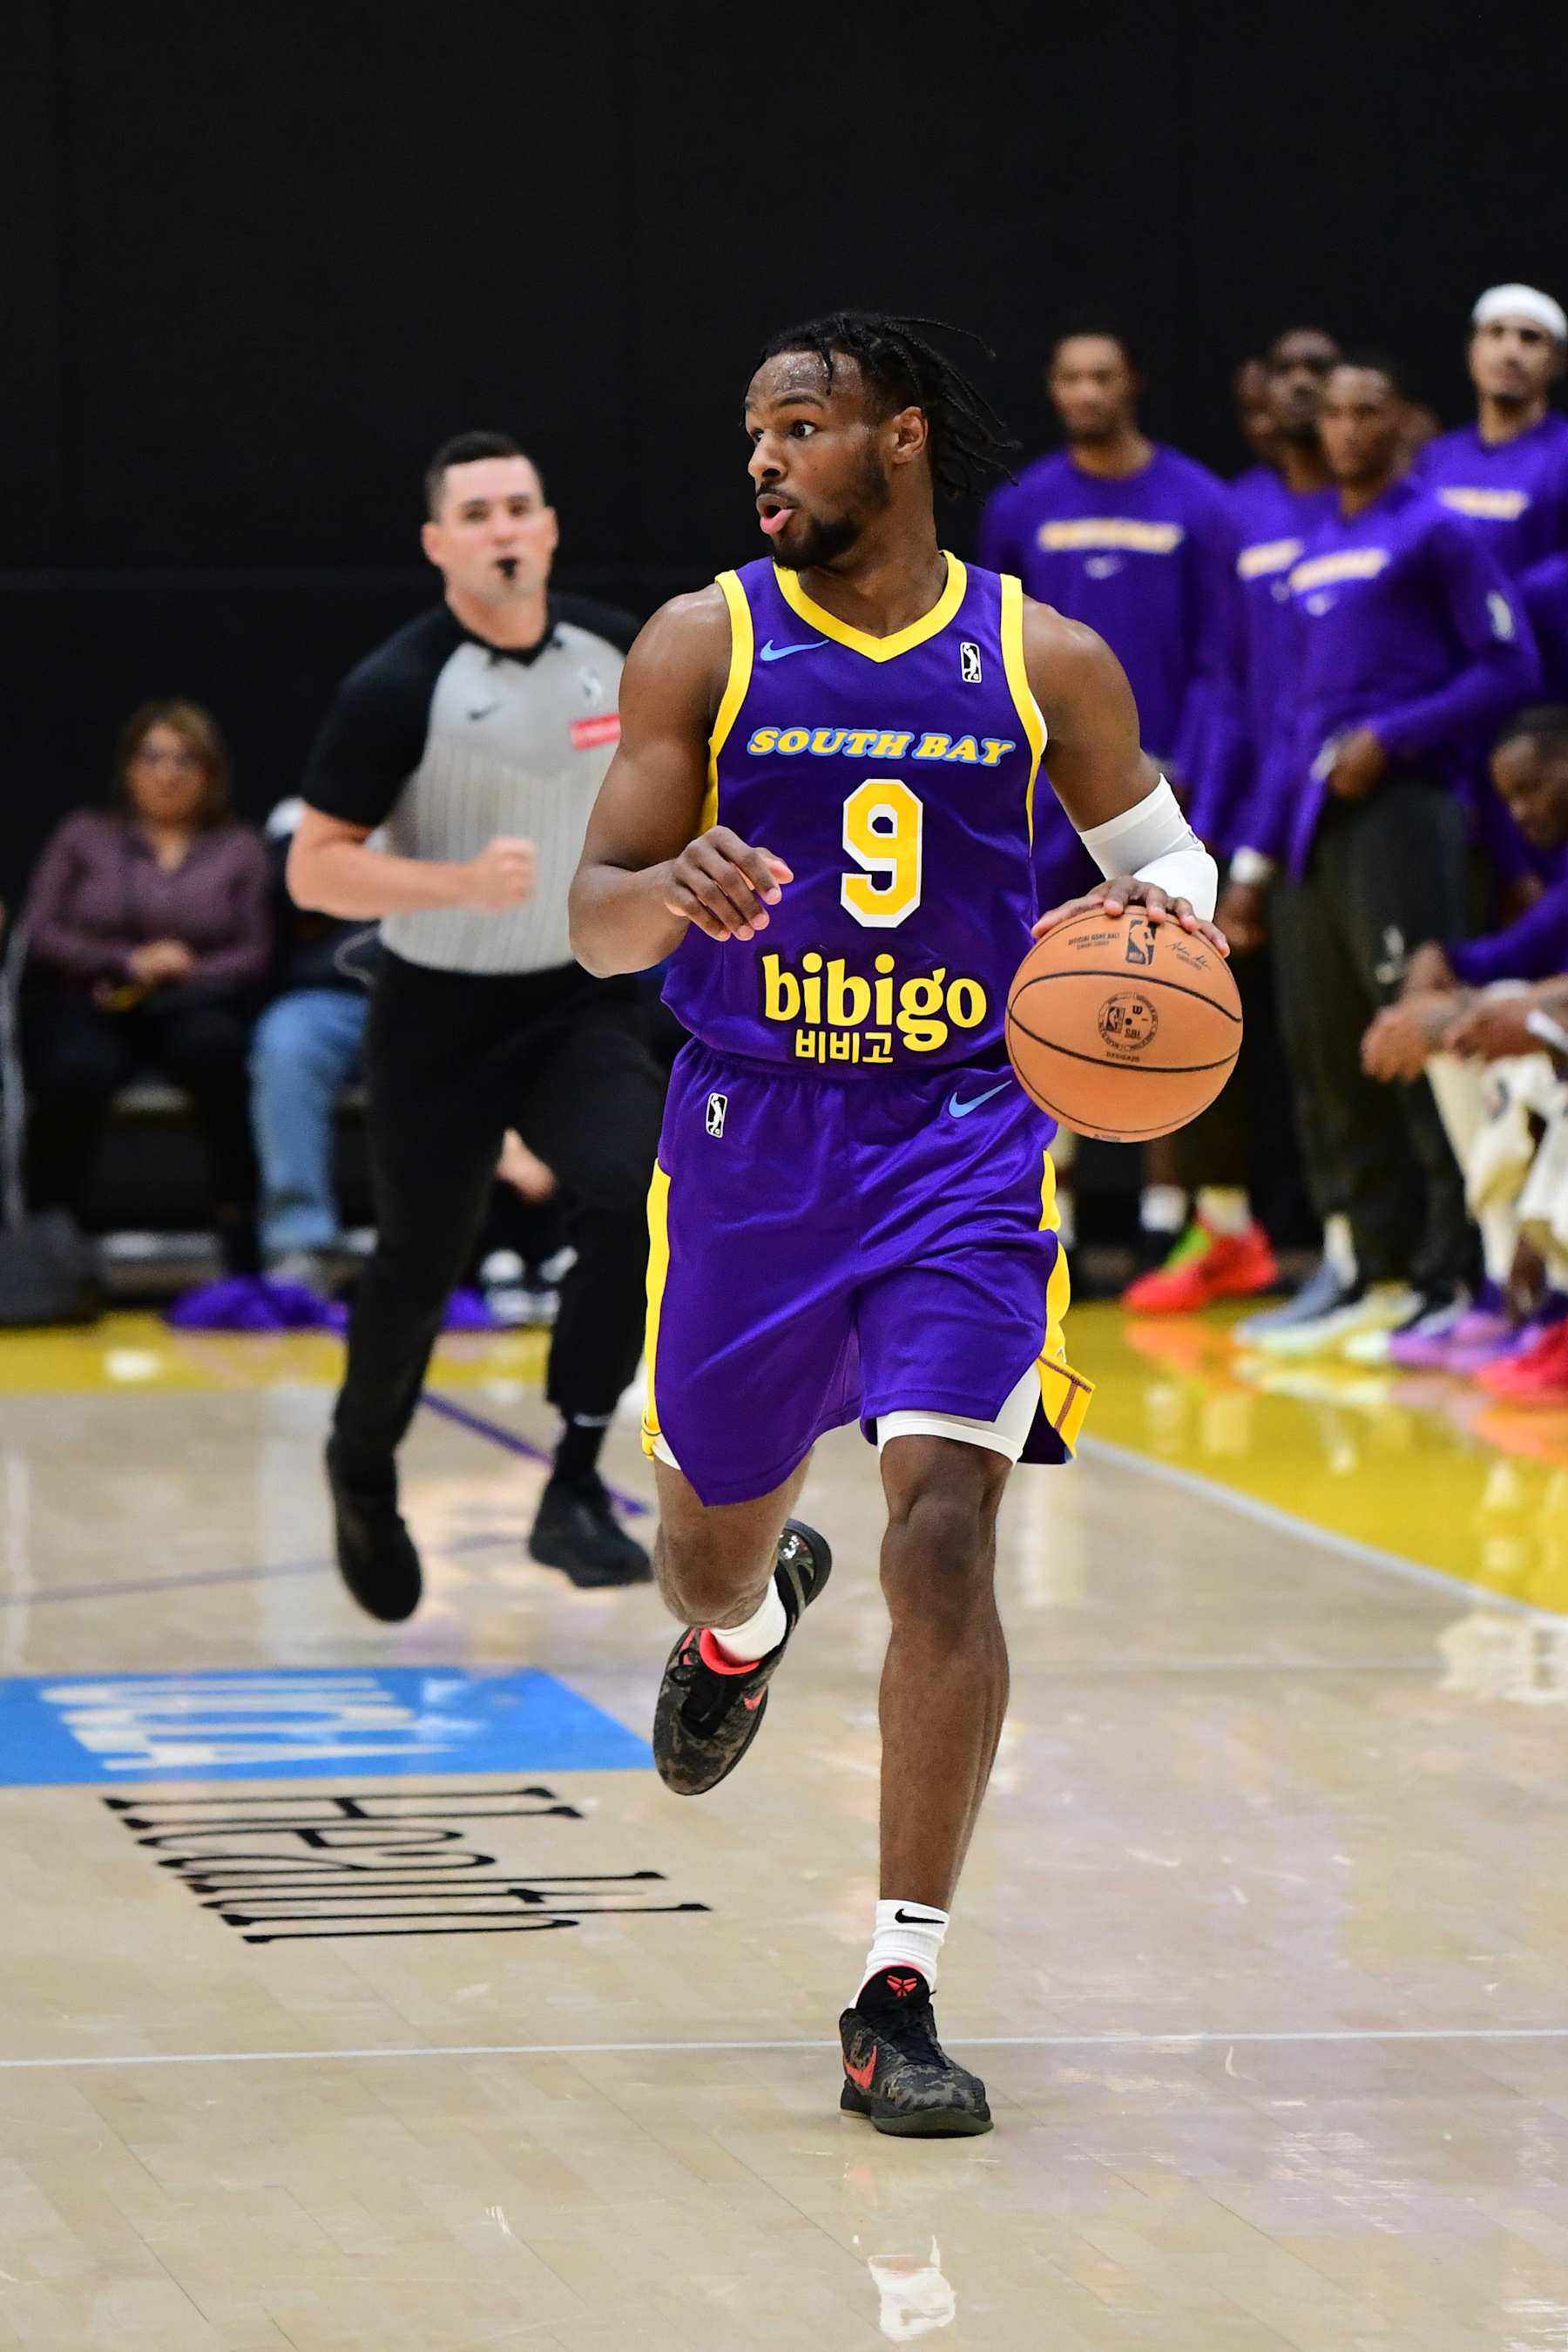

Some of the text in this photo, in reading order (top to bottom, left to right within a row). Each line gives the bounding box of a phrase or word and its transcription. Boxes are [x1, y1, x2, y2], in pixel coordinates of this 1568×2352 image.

[747, 727, 1016, 767] SOUTH BAY
[840, 778, 923, 929] 9
[762, 952, 987, 1051] bibigo
[795, 1029, 894, 1064] 비비고
[41, 1677, 462, 1771] UCLA
[101, 1787, 712, 1943] Health
